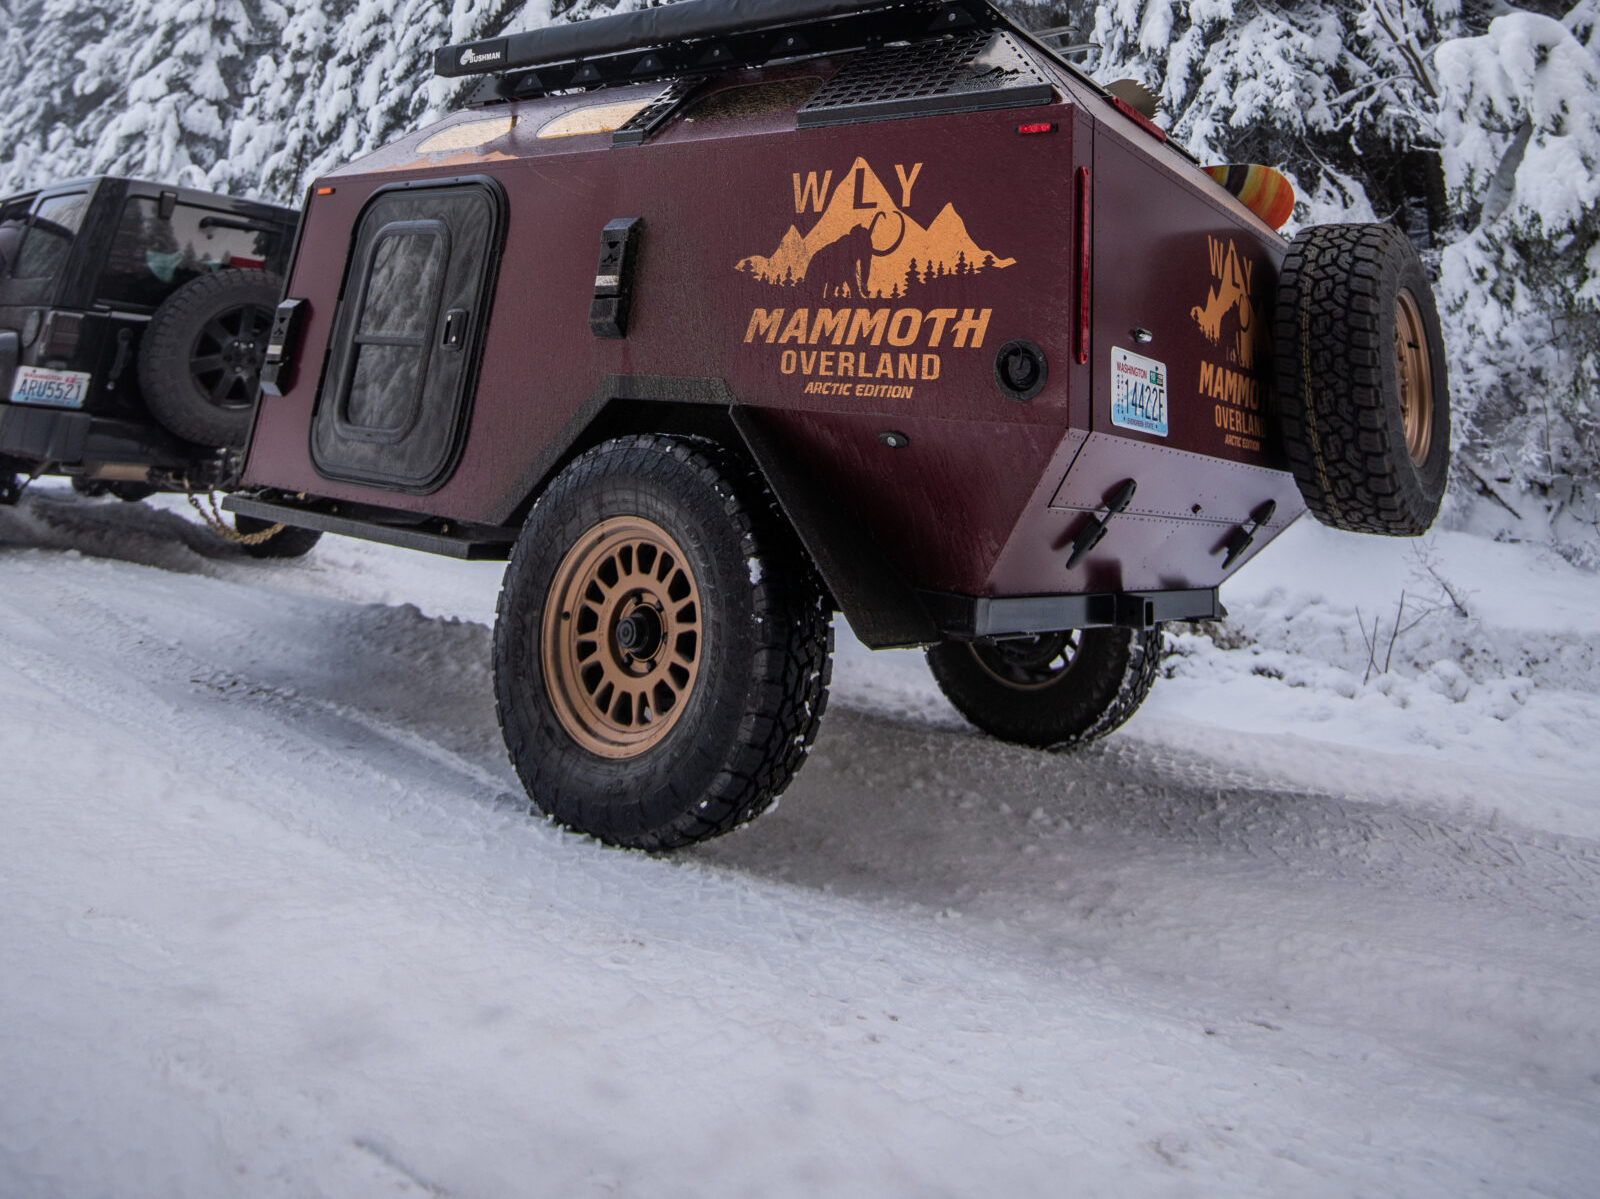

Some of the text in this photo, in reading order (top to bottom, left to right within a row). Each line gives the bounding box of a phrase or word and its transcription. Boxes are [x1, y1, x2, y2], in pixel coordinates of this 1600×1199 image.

[469, 51, 501, 63] BUSHMAN
[743, 308, 993, 348] MAMMOTH
[780, 350, 941, 380] OVERLAND
[1117, 362, 1147, 379] WASHINGTON
[18, 379, 82, 400] ARU5521
[804, 381, 914, 399] ARCTIC EDITION
[1125, 379, 1164, 422] 14422F
